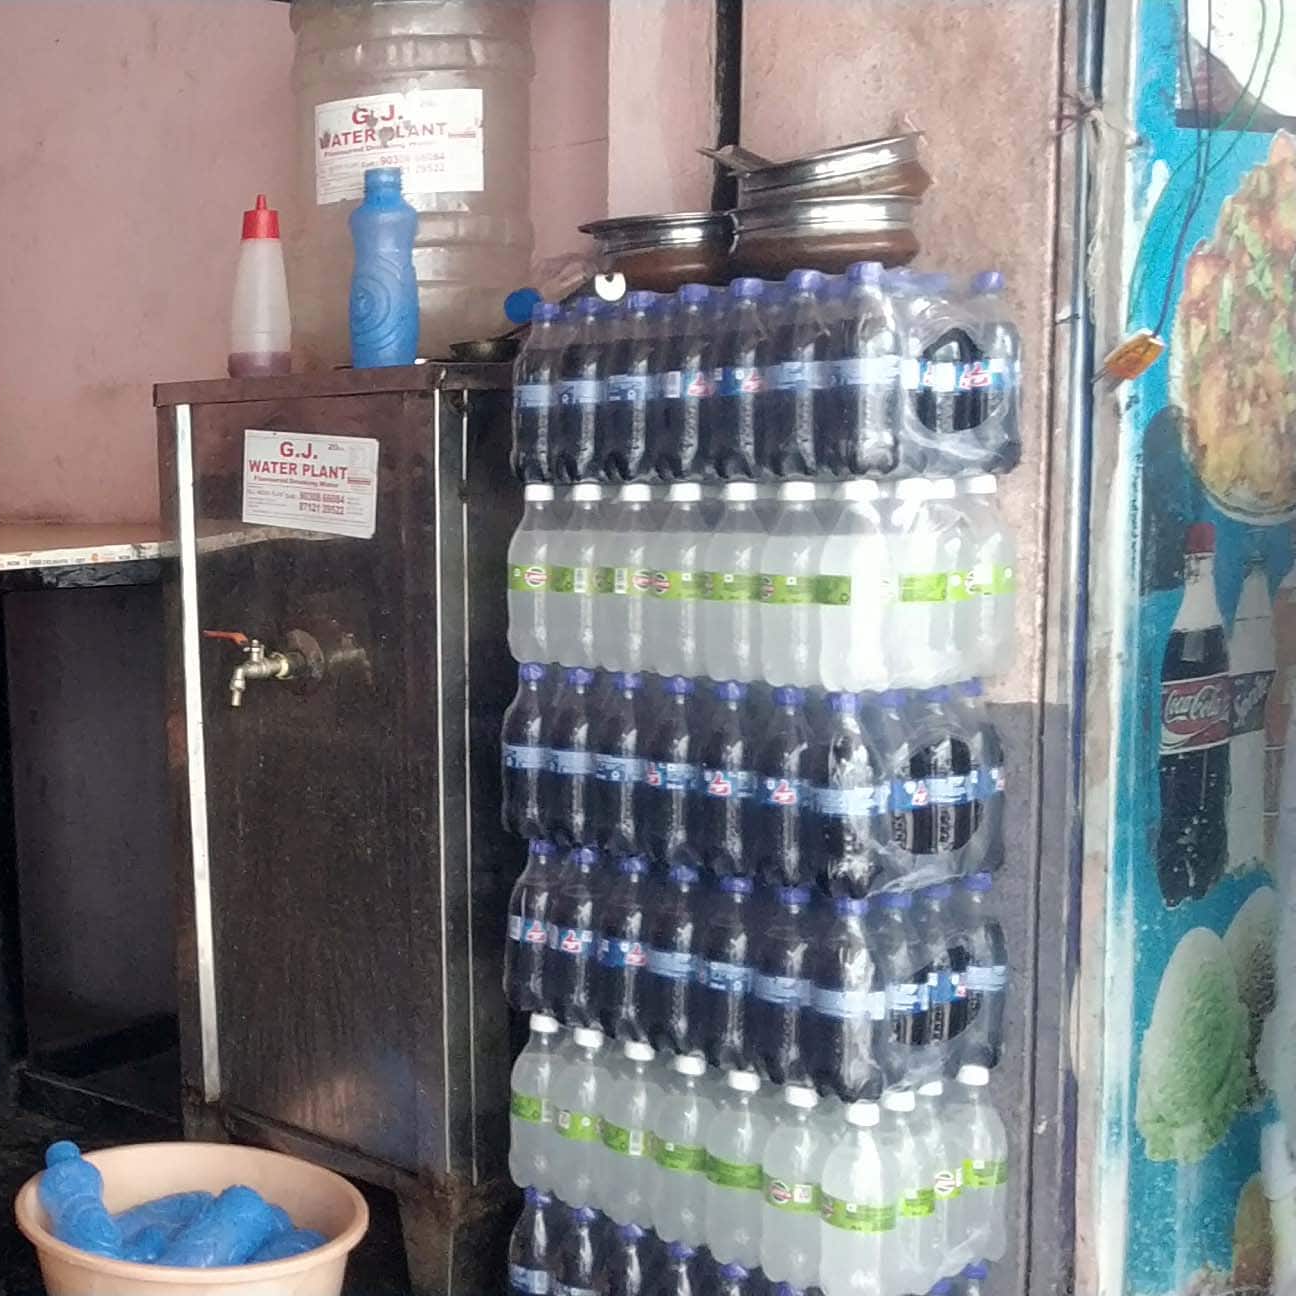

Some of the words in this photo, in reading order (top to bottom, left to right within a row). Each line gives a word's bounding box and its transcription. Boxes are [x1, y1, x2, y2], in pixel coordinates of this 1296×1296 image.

[319, 127, 377, 150] WATER
[379, 121, 448, 143] LANT
[279, 440, 318, 460] G.J.
[248, 459, 298, 476] WATER
[301, 463, 349, 480] PLANT
